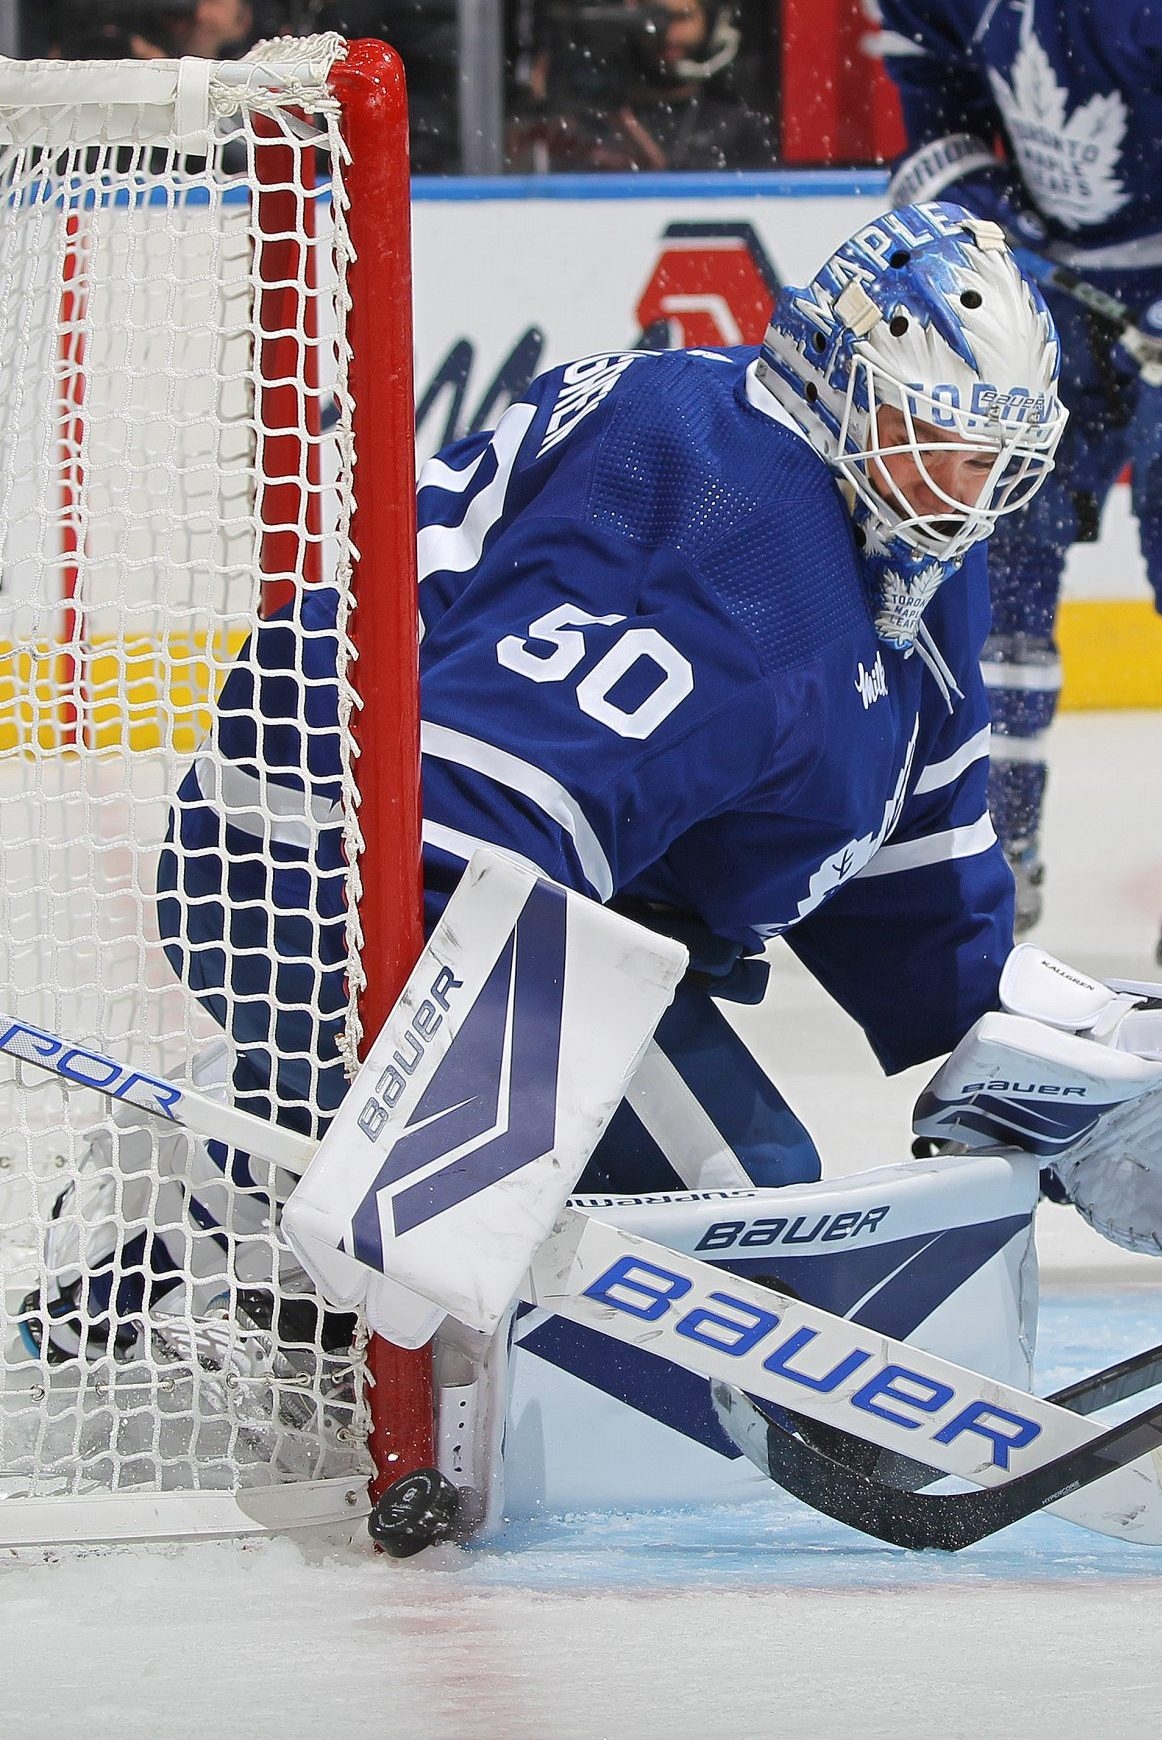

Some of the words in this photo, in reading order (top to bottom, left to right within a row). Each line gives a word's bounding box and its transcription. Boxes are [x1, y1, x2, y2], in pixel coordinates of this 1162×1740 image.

[795, 202, 968, 335] MAPLE
[496, 602, 695, 740] 50
[1041, 960, 1095, 992] KALLGREN
[356, 965, 465, 1144] BAUER
[961, 1080, 1088, 1099] BAUER
[695, 1205, 891, 1252] BAUER
[582, 1254, 1044, 1473] BAUER
